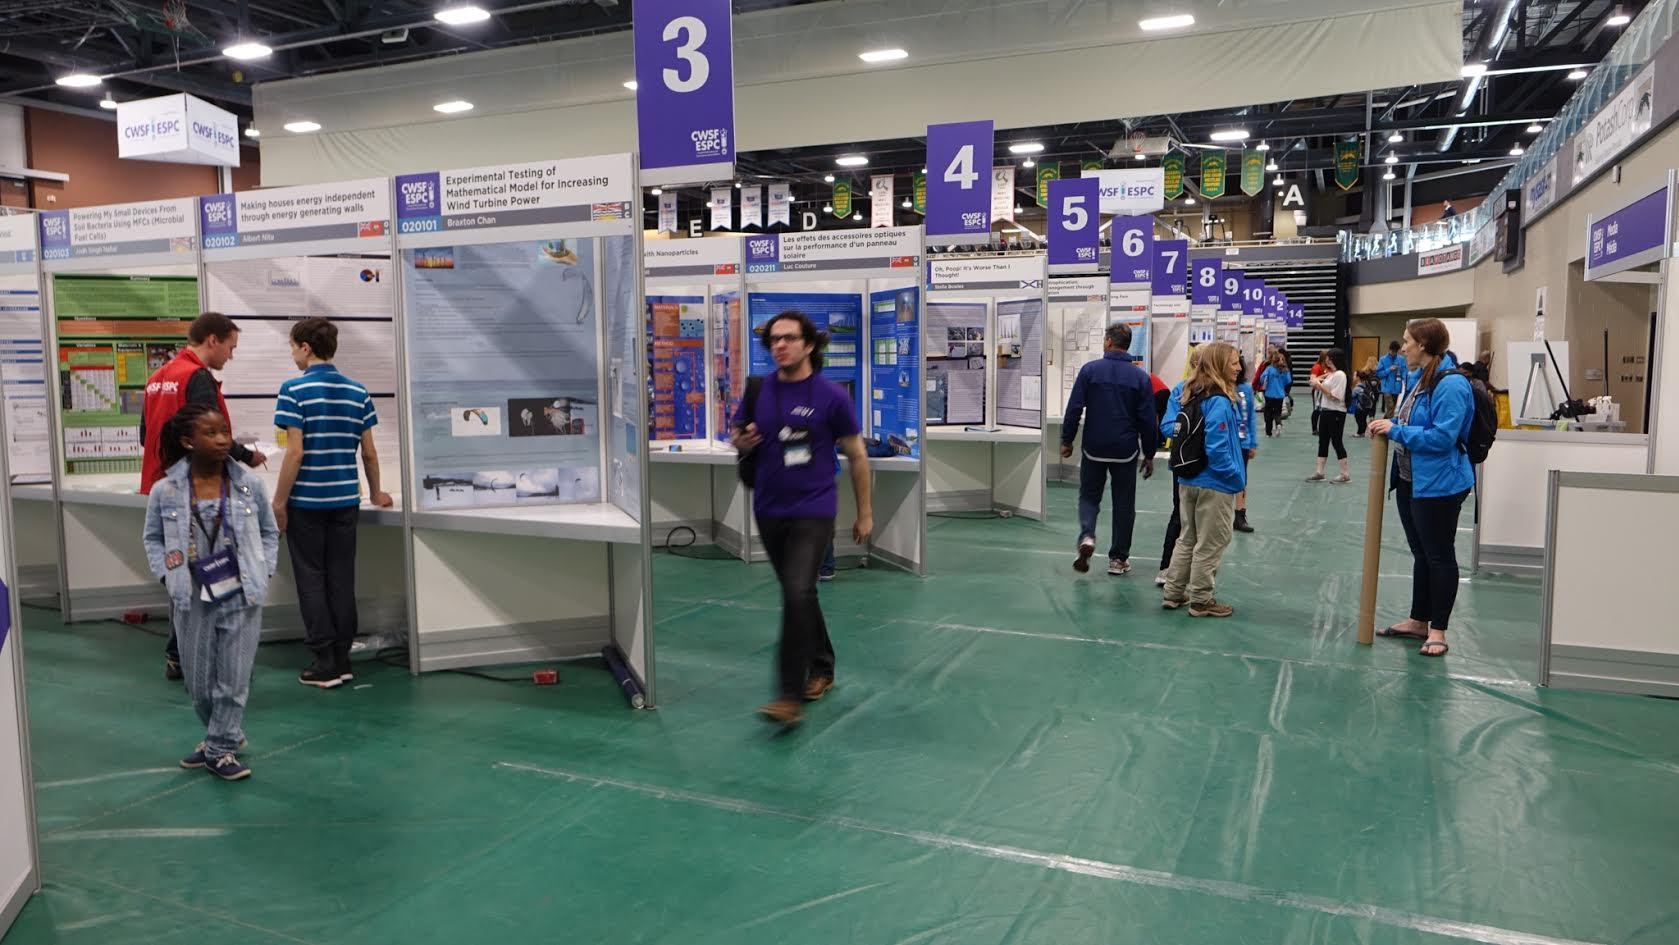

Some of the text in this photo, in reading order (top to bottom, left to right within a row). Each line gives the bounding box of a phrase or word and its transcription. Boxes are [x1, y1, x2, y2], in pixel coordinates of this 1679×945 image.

[662, 16, 710, 93] 3
[125, 120, 180, 138] CWSF ESPC
[193, 121, 234, 148] CWSF ESPC
[691, 129, 720, 141] CWSF
[696, 139, 720, 151] ESPC
[944, 144, 979, 189] 4
[446, 166, 556, 187] Experimental Testing of
[401, 182, 427, 195] CWSF
[446, 176, 609, 198] Mathematical Model for Increasing
[1099, 186, 1155, 197] WSF ESPC
[241, 190, 375, 212] Making houses energy independent
[405, 193, 428, 204] ESPC
[1282, 184, 1305, 206] A
[204, 201, 226, 212] CWSF
[447, 195, 540, 211] Wind Turbine Power
[133, 206, 157, 216] Devices
[159, 205, 177, 213] From
[208, 210, 227, 222] ESPC
[241, 203, 364, 224] through energy generating walls
[962, 212, 981, 220] CWSF
[1062, 195, 1088, 231] 5
[402, 216, 497, 233] 020101 Braxton Chan
[802, 212, 817, 230] D
[964, 218, 982, 227] ESPC
[689, 219, 702, 237] E
[205, 236, 236, 248] 020102
[784, 230, 906, 243] Les effets des accessoires optiques
[1122, 228, 1145, 257] 6
[749, 239, 769, 248] CWSF
[795, 243, 802, 251] la
[803, 241, 847, 251] performance
[850, 240, 864, 248] d'un
[867, 239, 897, 248] panneau
[657, 248, 699, 258] Nanoparticles
[752, 246, 770, 255] ESPC
[784, 251, 806, 259] solaire
[750, 264, 775, 273] 020211
[795, 261, 817, 270] Couture
[1161, 250, 1179, 274] 7
[1199, 267, 1215, 287] 8
[1225, 278, 1239, 295] 9
[1243, 288, 1263, 301] 10
[1289, 309, 1303, 318] 14
